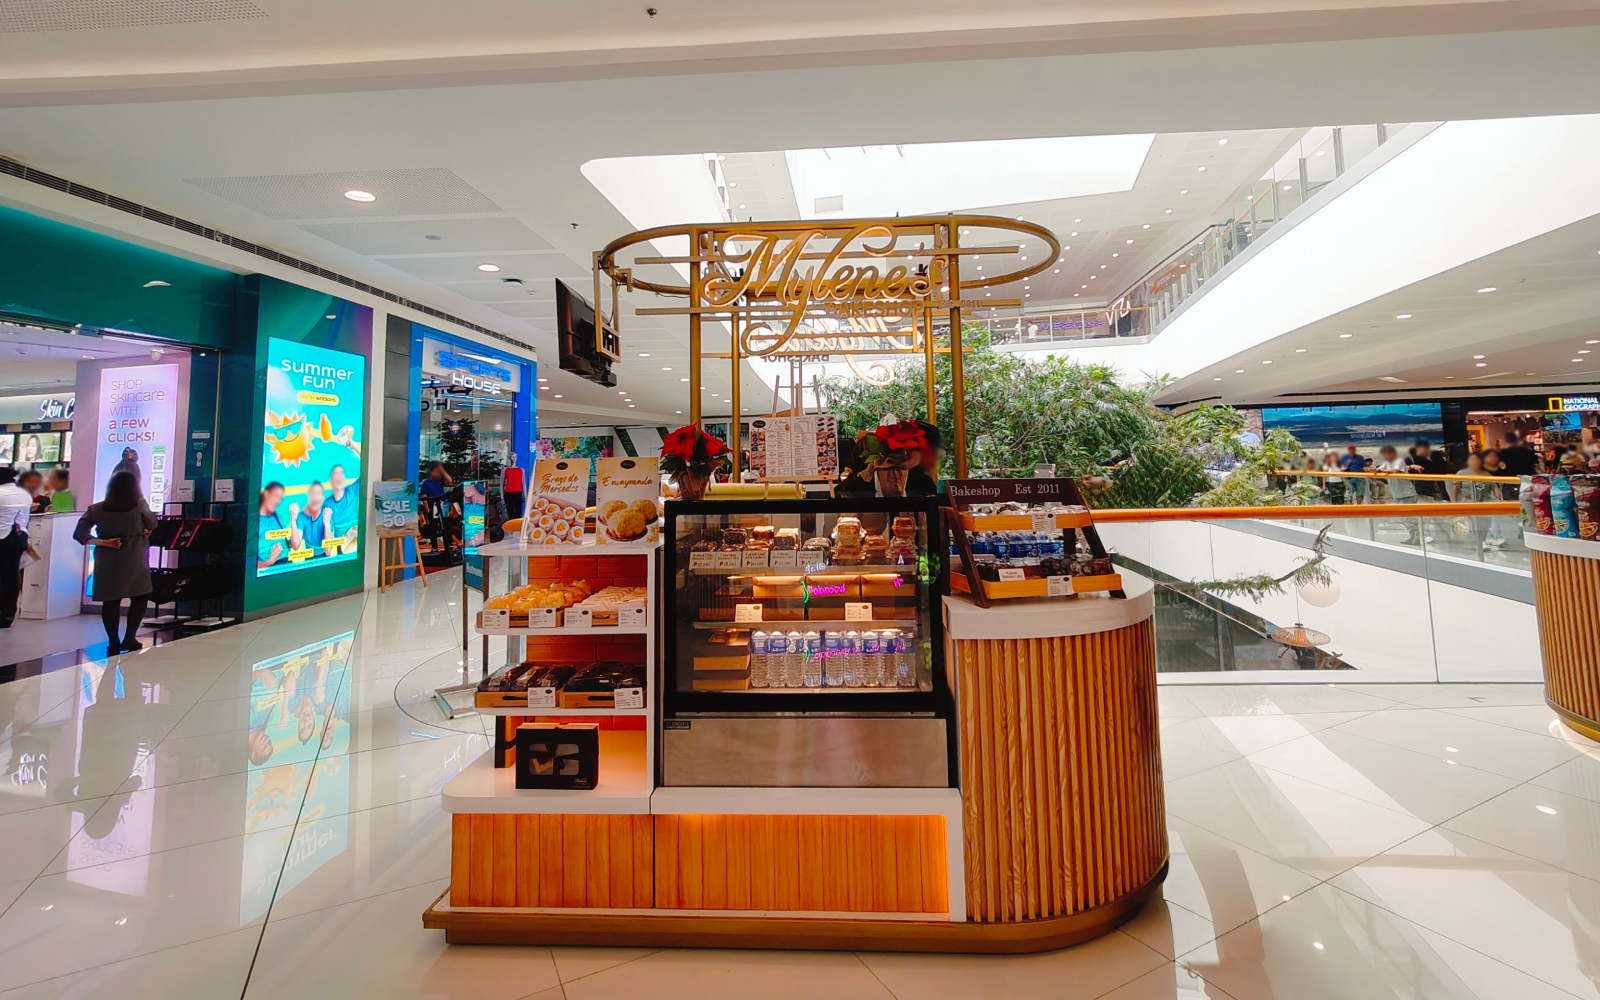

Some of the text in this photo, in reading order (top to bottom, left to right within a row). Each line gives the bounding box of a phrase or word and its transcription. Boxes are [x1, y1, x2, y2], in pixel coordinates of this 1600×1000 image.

[824, 300, 923, 318] BAKESHOP
[438, 350, 512, 382] SPORTS
[111, 379, 143, 390] SHOP
[452, 372, 502, 394] HOUSE
[37, 399, 63, 420] Skin
[110, 406, 138, 416] WITH
[108, 432, 155, 443] CLICKS!
[950, 484, 1060, 498] Bakeshop Est 2011
[382, 500, 411, 513] SALE
